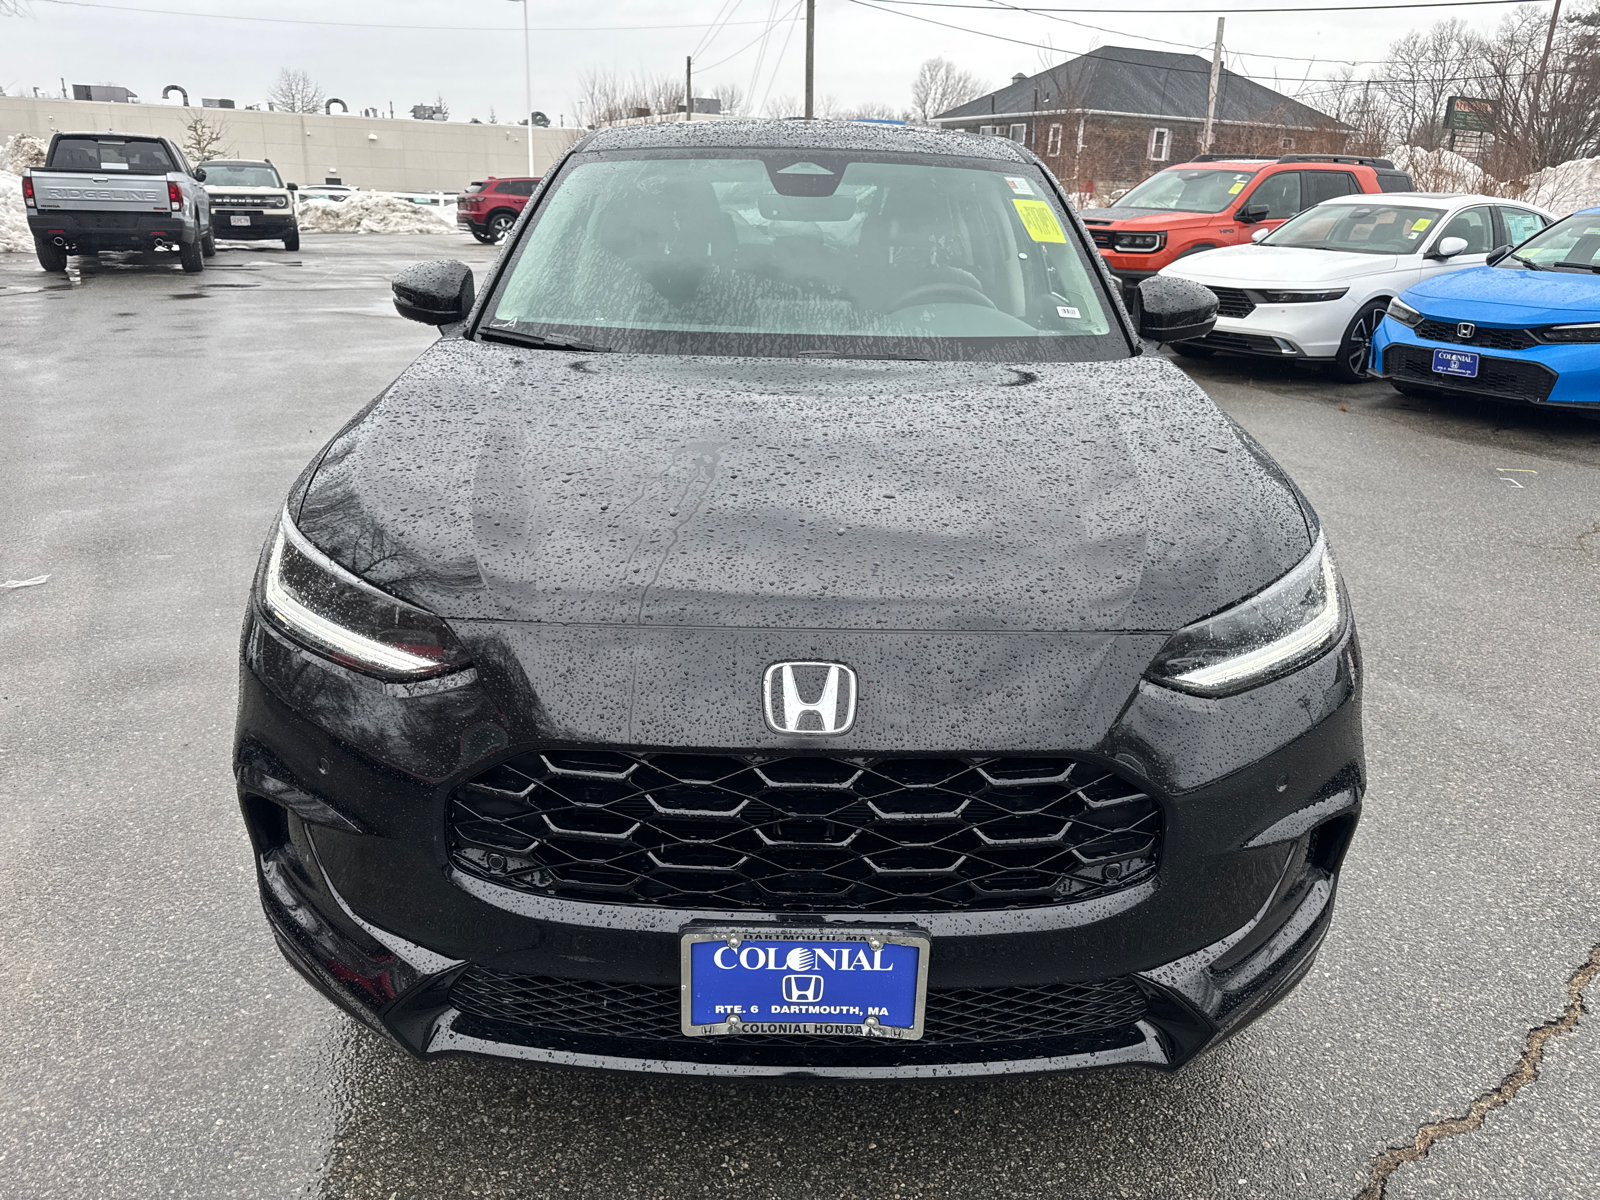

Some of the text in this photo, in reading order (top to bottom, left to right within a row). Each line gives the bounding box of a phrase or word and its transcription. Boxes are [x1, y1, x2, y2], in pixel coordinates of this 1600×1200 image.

[47, 188, 158, 201] RIDGELINE
[1438, 352, 1473, 363] COLONIAL
[713, 946, 894, 972] COLONIAL
[715, 1005, 889, 1016] RTE. 6 DARTMOUTH, MA
[741, 1023, 864, 1035] COLONIAL HONDA
